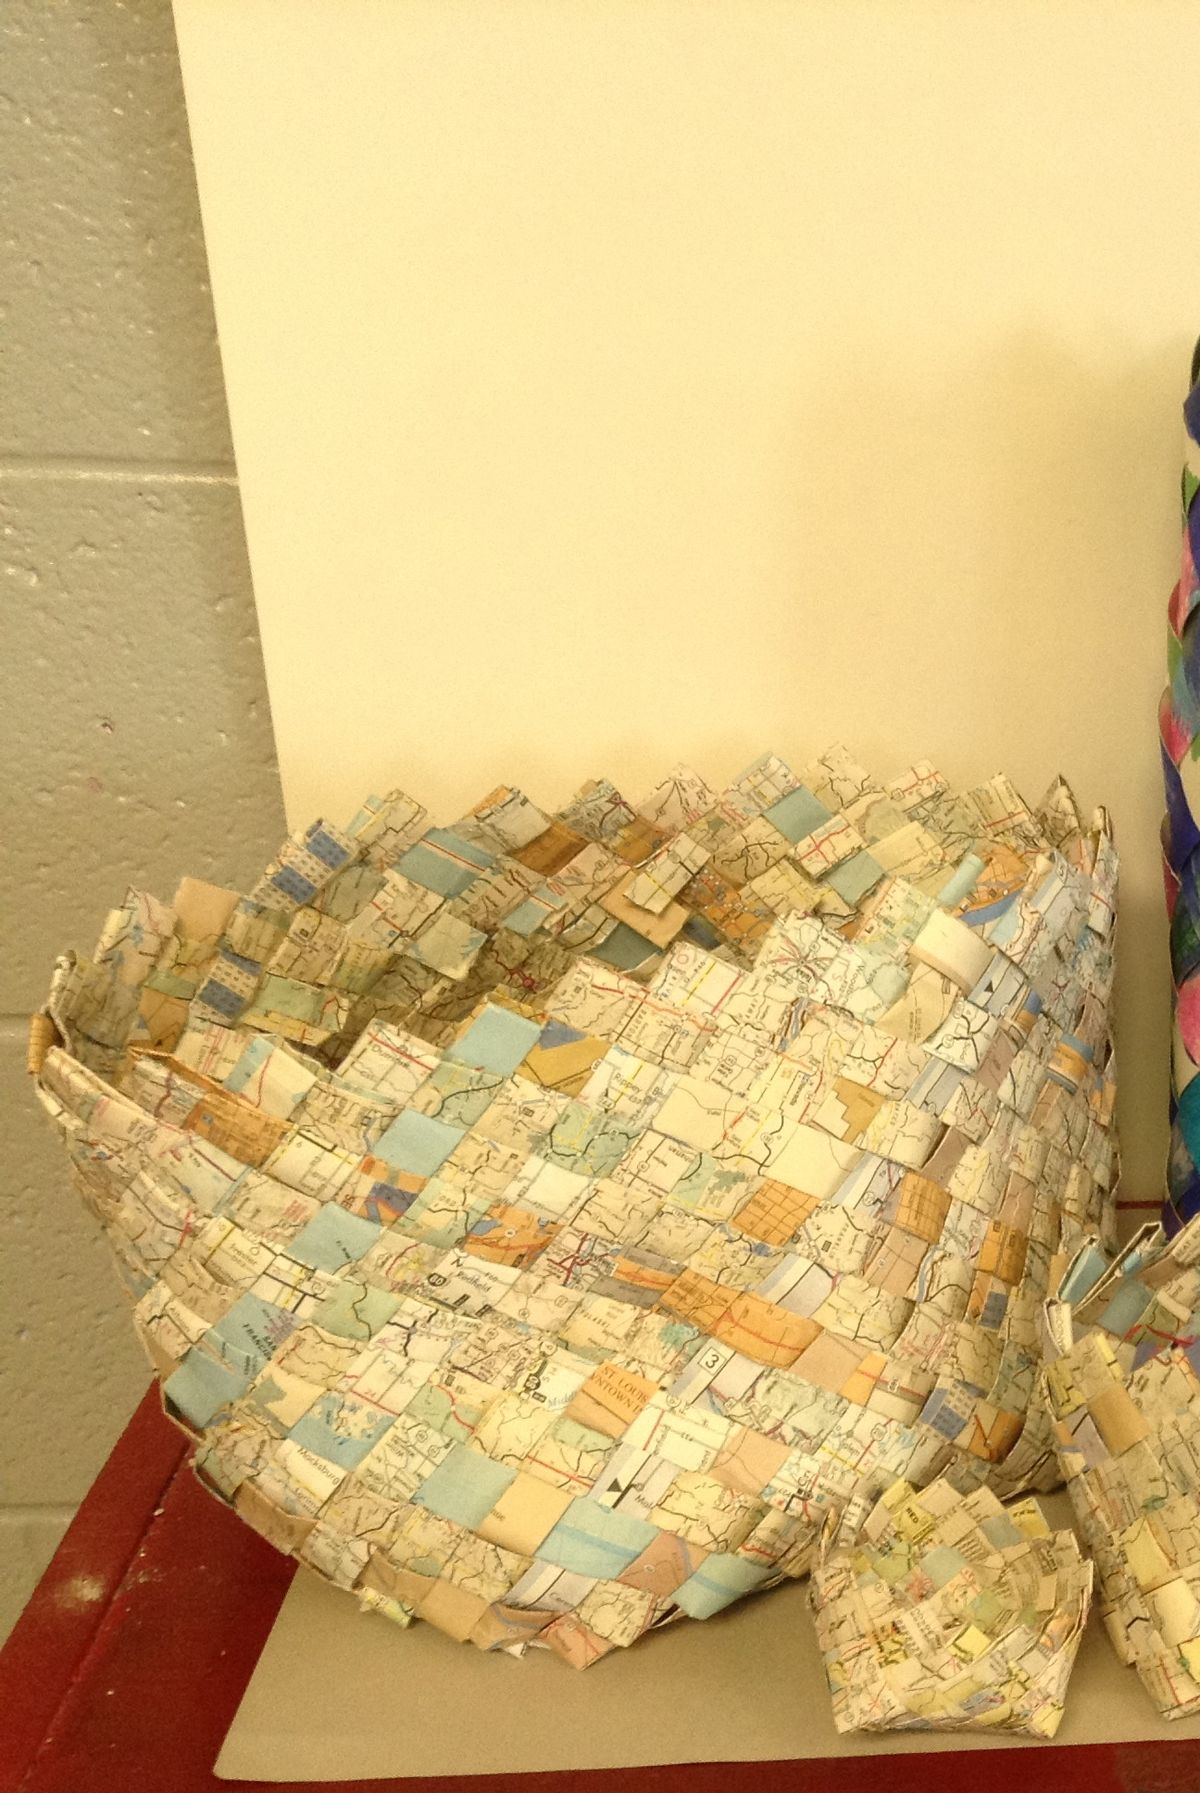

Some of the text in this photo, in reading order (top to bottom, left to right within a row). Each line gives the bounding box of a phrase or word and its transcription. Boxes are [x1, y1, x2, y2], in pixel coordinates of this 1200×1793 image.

[704, 1353, 721, 1370] 3
[619, 1377, 650, 1404] LOUIS
[905, 1507, 919, 1524] RED
